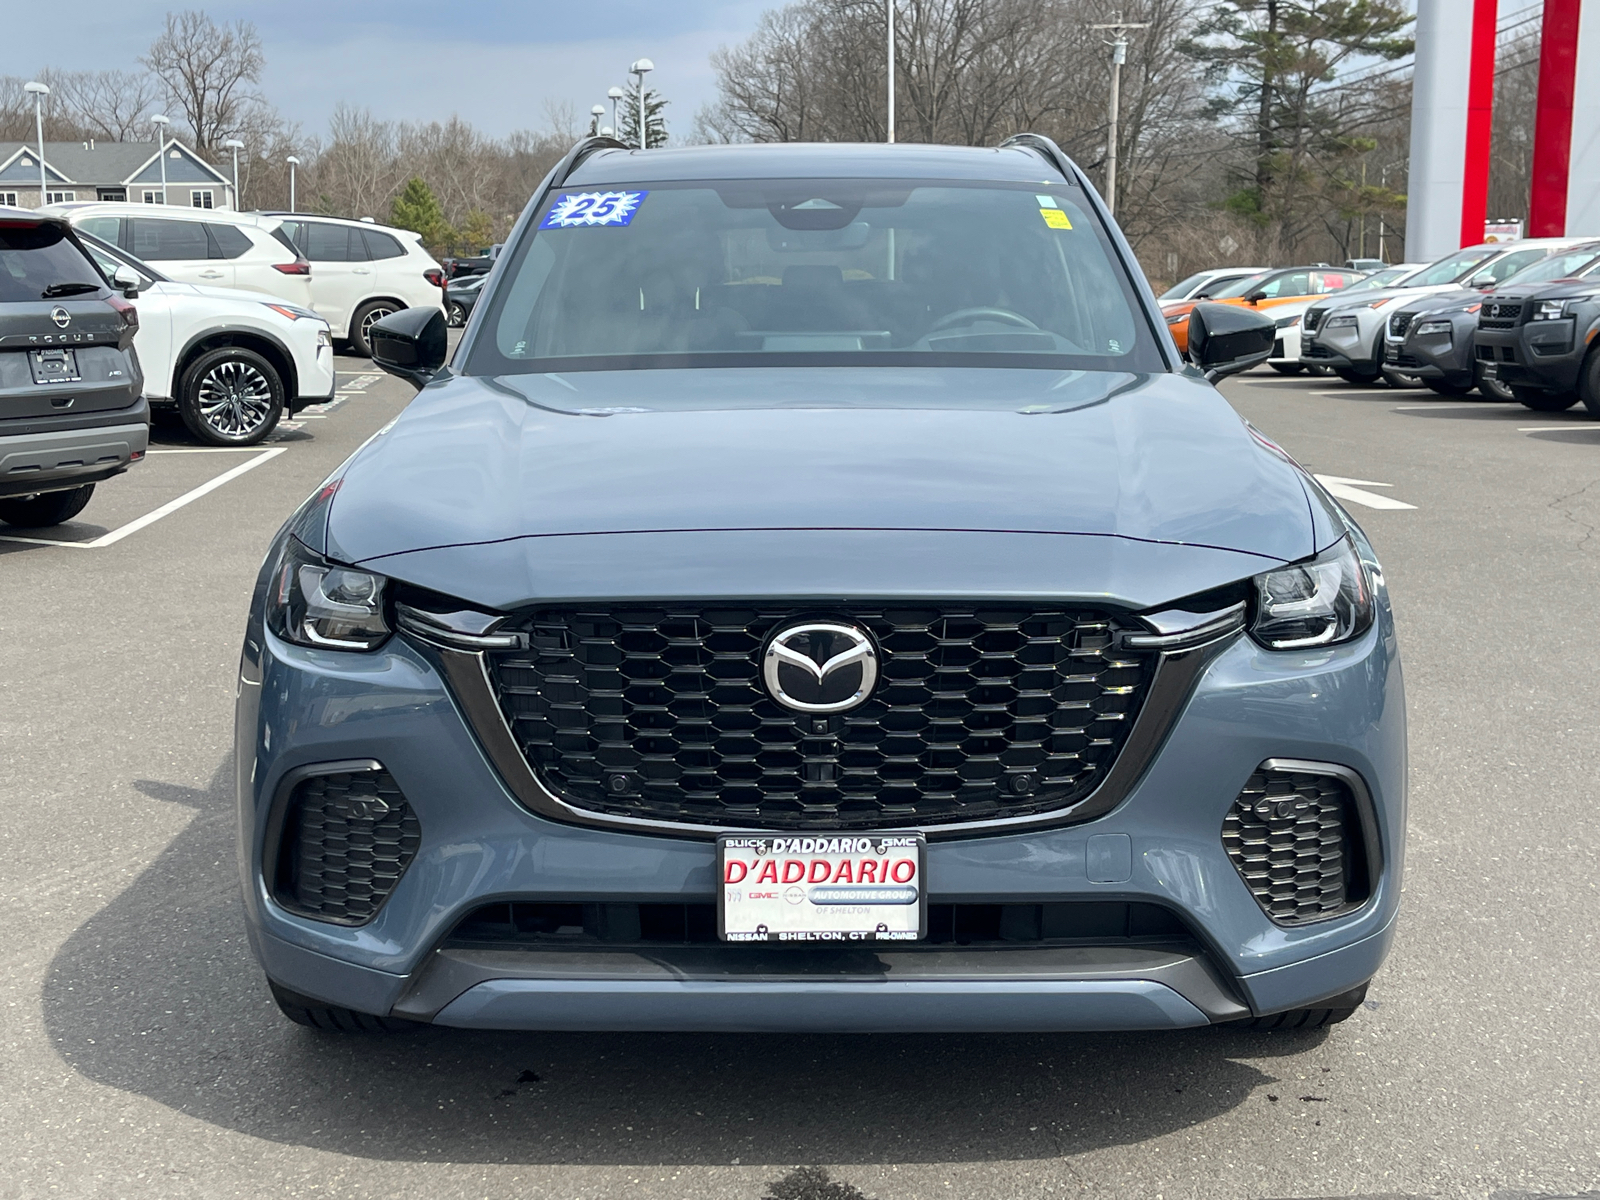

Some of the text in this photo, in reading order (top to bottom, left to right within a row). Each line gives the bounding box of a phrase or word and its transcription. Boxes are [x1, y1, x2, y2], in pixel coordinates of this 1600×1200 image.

[565, 197, 621, 219] 25
[725, 838, 917, 854] BUICK D'ADDARIO GMC
[724, 859, 916, 884] D'ADDARIO
[748, 891, 779, 899] GMC
[813, 889, 913, 900] AUTOMOTIVE GROUP
[815, 906, 871, 915] OF SHELTON
[727, 931, 918, 941] NISSAN SHELTON, CT PRE-OWNED
